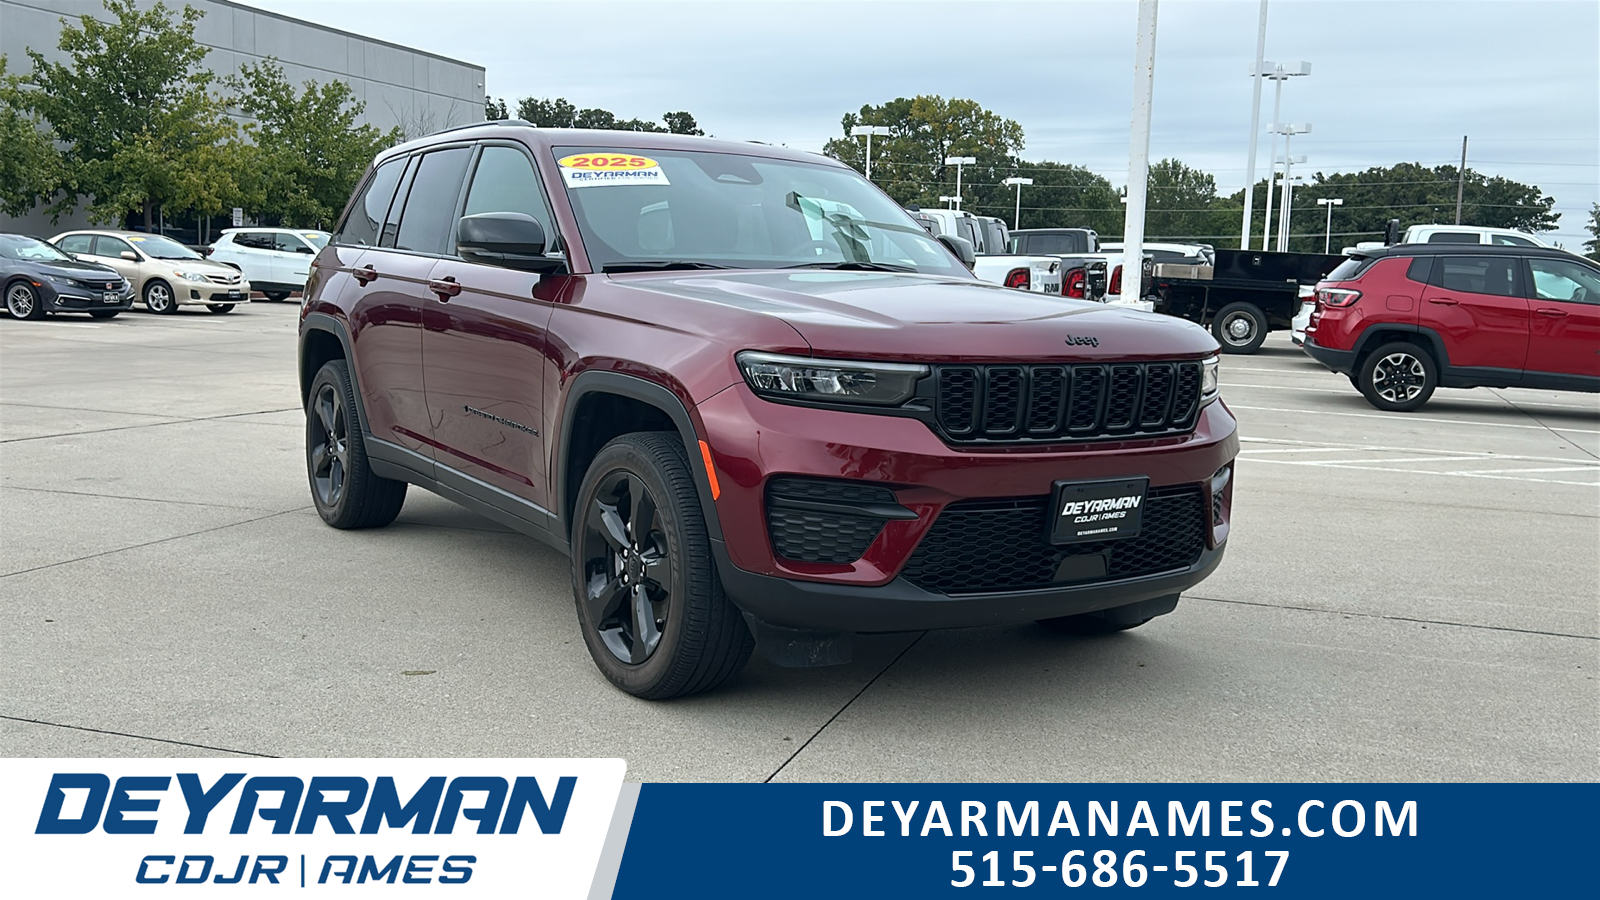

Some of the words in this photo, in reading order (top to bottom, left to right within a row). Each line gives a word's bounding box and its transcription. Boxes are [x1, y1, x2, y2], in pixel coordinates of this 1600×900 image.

[572, 157, 646, 167] 2025
[571, 171, 658, 179] DEYARMAN
[1065, 334, 1099, 348] Jeep
[1061, 495, 1142, 516] DEYARMAN
[1073, 513, 1099, 524] CDJR
[1101, 511, 1127, 521] AMES
